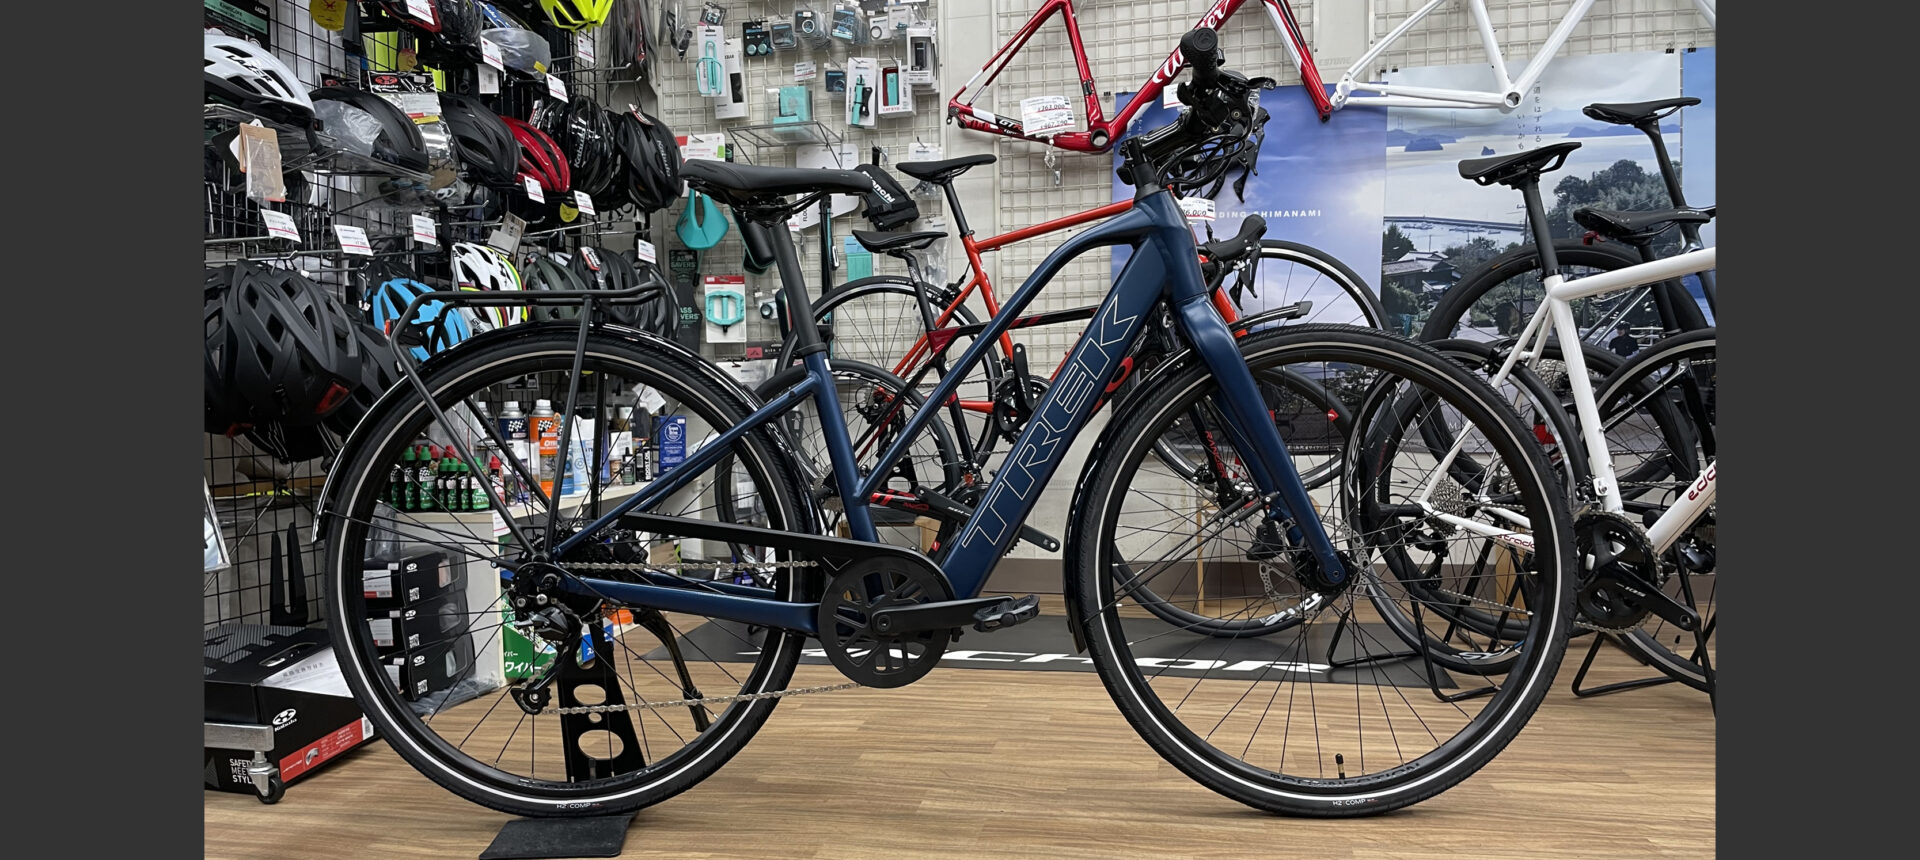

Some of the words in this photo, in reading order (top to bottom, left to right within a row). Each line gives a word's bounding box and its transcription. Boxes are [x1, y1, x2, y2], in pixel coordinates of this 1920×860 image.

[226, 55, 273, 82] LAZER
[962, 293, 1138, 548] TREK
[1204, 430, 1228, 479] RANGER
[274, 718, 298, 732] Kabuto
[231, 767, 249, 776] MEE
[233, 775, 253, 785] STYL
[1346, 798, 1366, 806] COMP
